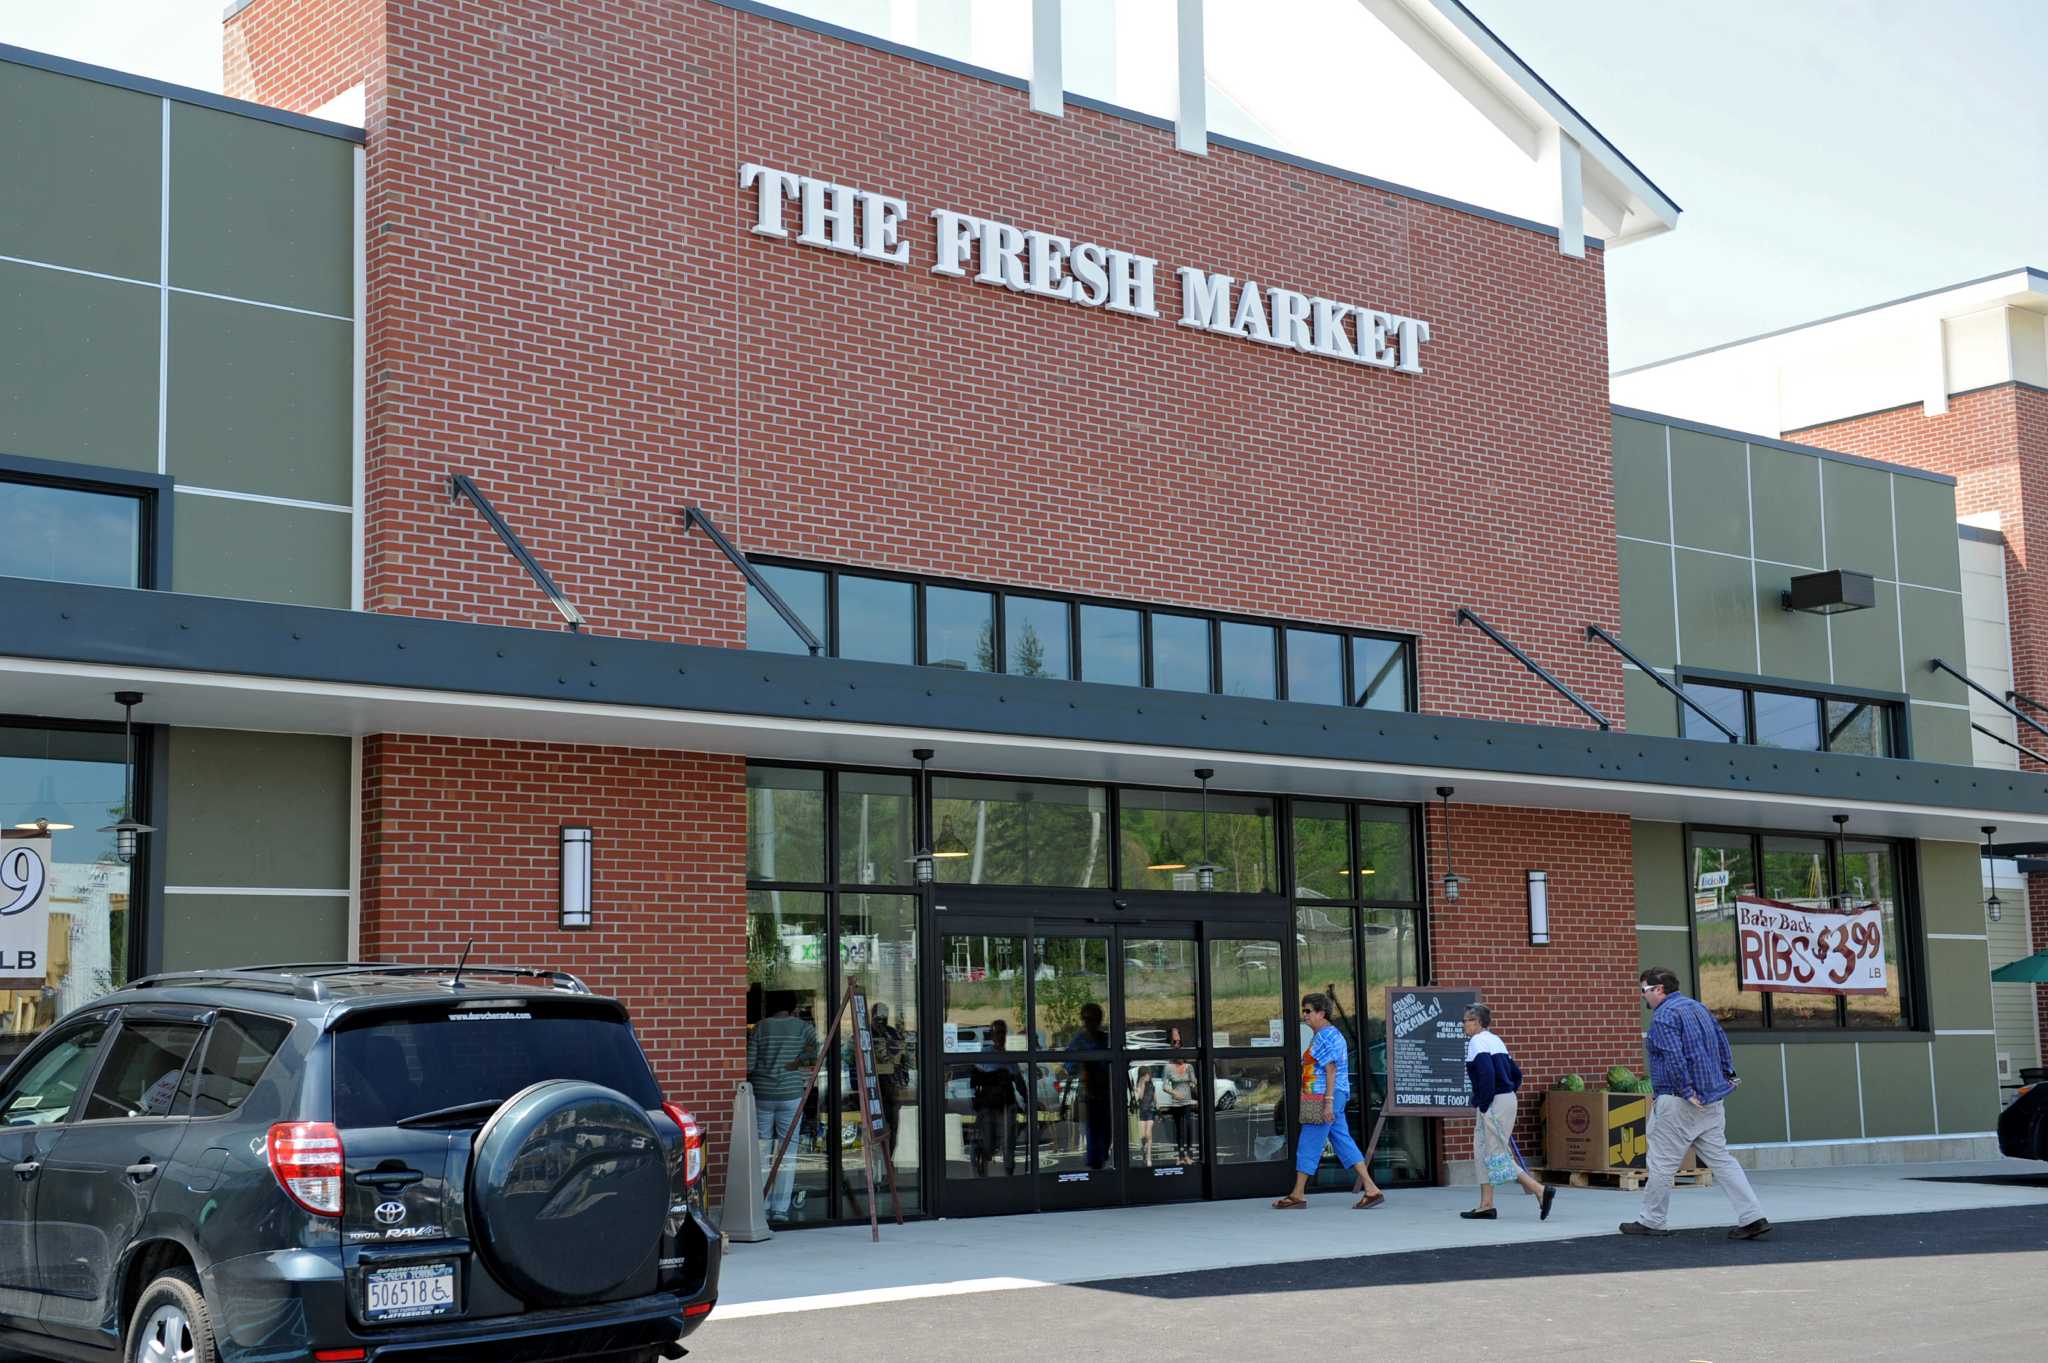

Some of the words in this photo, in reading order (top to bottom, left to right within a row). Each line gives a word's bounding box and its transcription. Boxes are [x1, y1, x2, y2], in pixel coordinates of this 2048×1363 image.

[740, 163, 910, 265] THE
[931, 207, 1160, 318] FRESH
[1177, 266, 1430, 374] MARKET
[1741, 908, 1777, 932] Baby
[1778, 913, 1815, 933] Back
[0, 951, 36, 969] LB
[1741, 930, 1815, 983] RIBS
[1868, 967, 1882, 979] LB
[1392, 993, 1416, 1014] GRAND
[1393, 1001, 1425, 1025] OPENING
[1394, 996, 1442, 1038] SPECIALS!
[1396, 1094, 1432, 1105] EXPERIENCE
[1434, 1095, 1446, 1105] THE
[1447, 1095, 1470, 1106] FOOD!
[349, 1232, 381, 1240] TOYOTA
[371, 1280, 428, 1308] 506518
